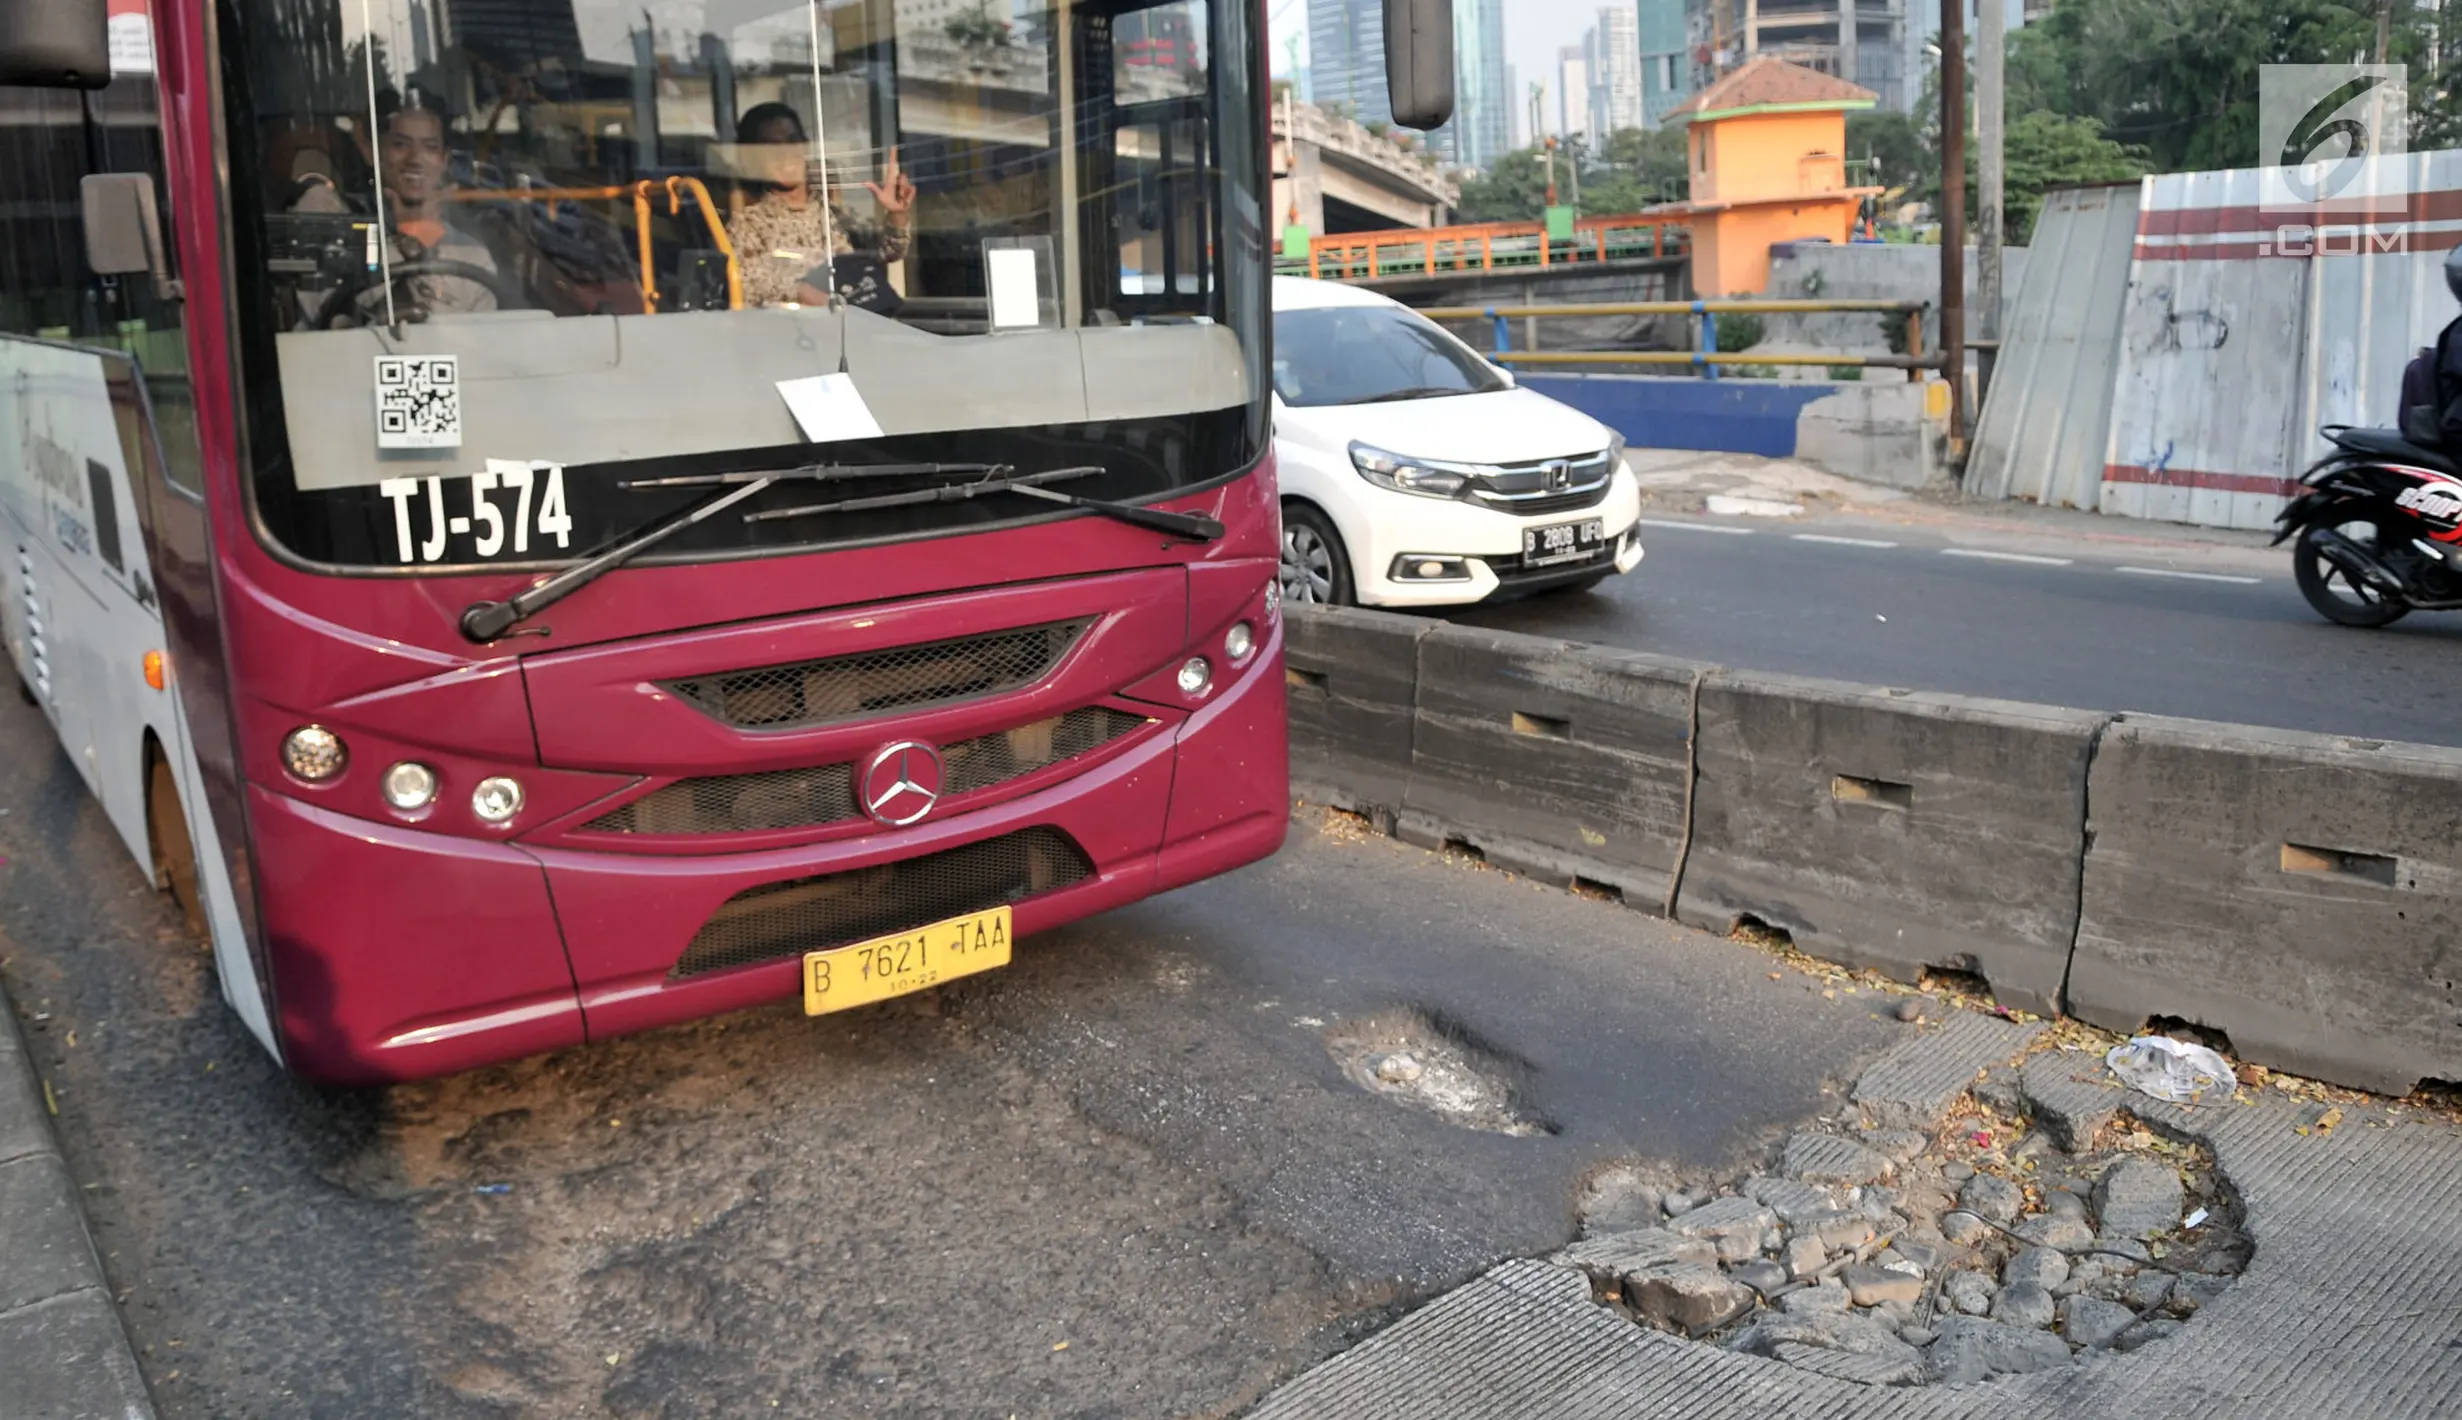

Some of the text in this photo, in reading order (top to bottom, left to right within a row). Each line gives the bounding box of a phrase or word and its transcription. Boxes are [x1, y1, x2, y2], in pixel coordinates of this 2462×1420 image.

[380, 465, 573, 563] TJ-574
[813, 915, 1006, 994] B 7621 TAA
